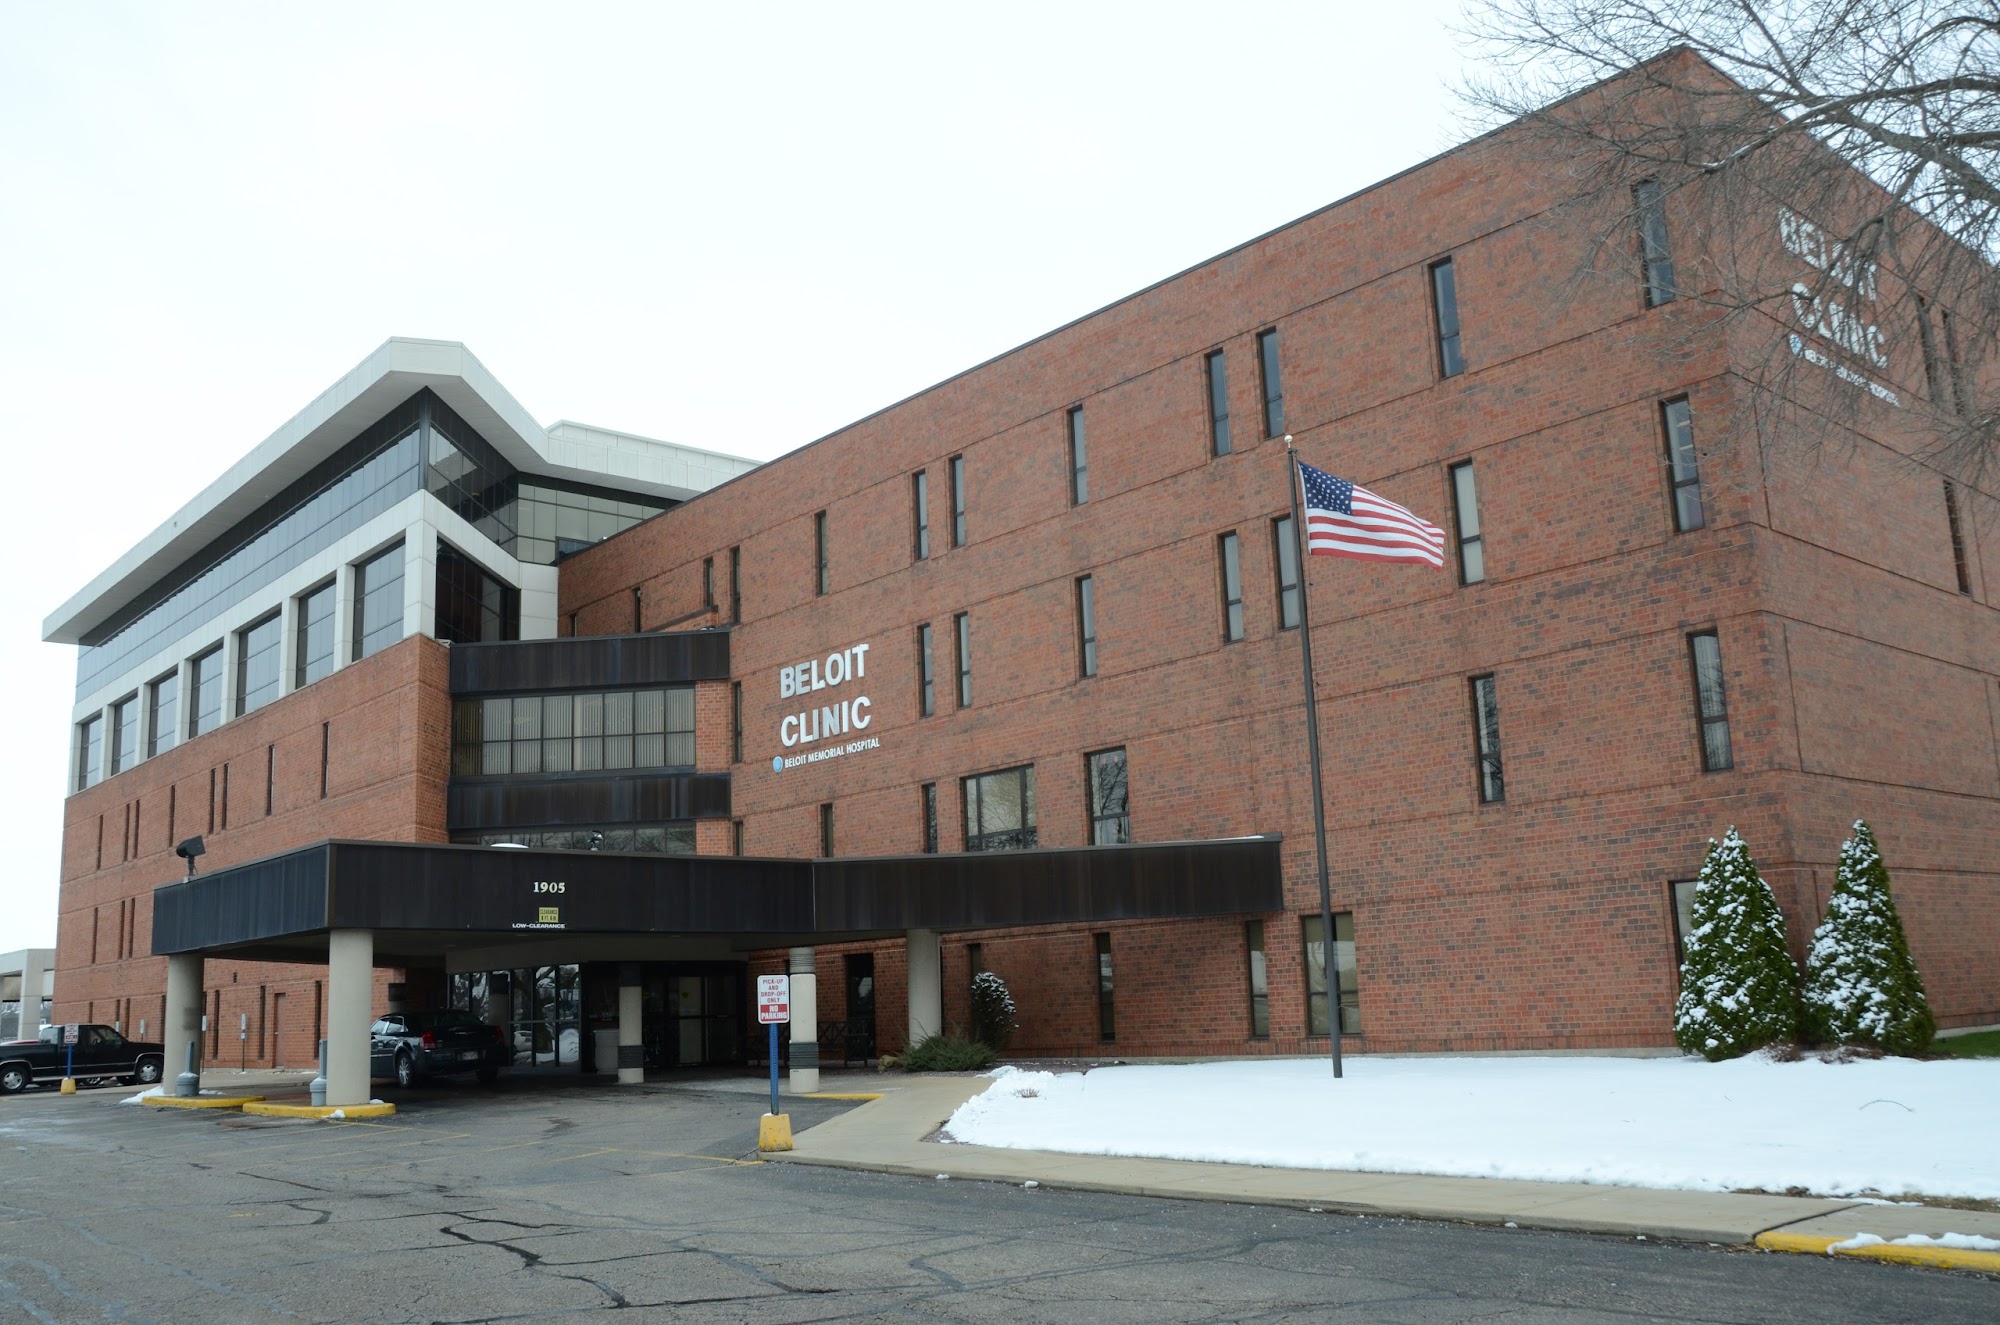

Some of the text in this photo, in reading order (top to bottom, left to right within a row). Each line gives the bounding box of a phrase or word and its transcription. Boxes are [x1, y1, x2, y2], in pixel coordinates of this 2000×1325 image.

[780, 643, 870, 699] BELOIT
[781, 696, 872, 747] CLINIC
[784, 738, 880, 769] BELOIT MEMORIAL HOSPITAL
[533, 881, 566, 894] 1905
[761, 1012, 787, 1020] PARKING
